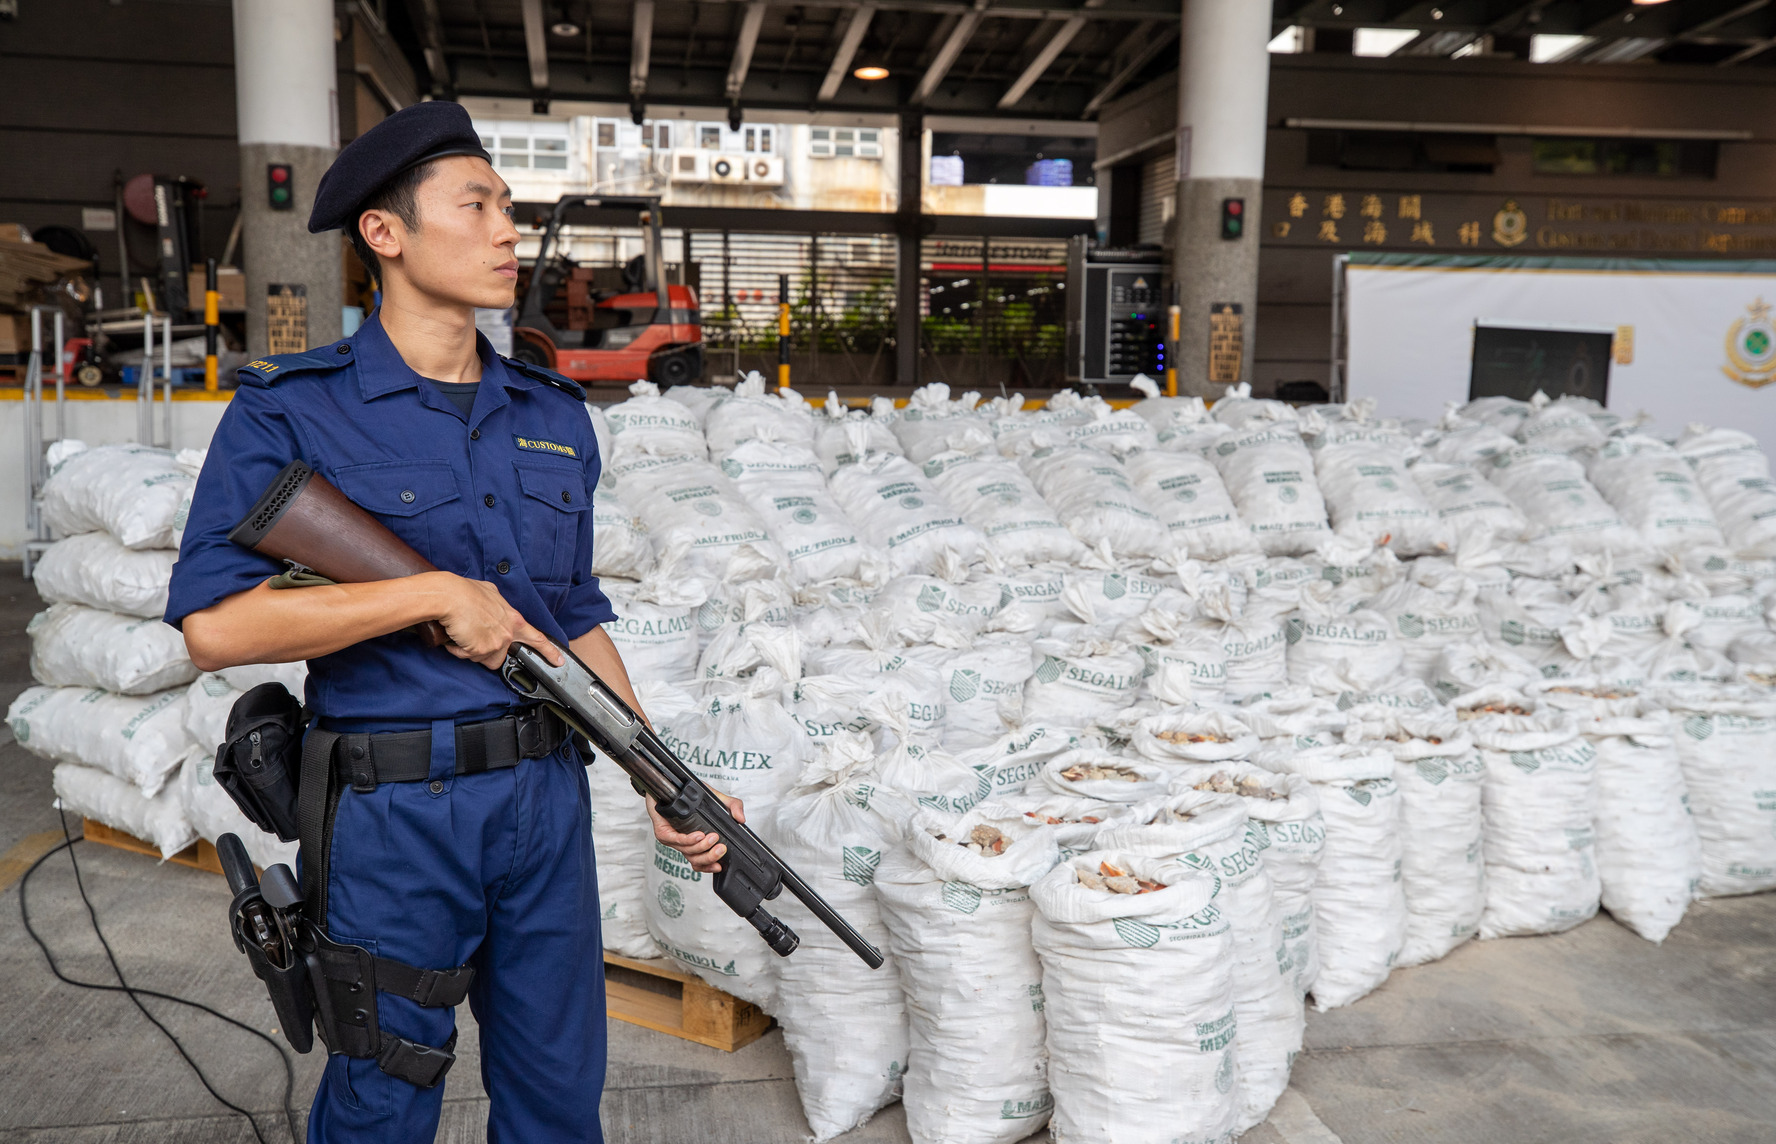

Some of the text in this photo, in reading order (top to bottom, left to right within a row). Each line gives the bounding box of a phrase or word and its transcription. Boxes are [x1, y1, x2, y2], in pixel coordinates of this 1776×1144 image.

[1074, 421, 1147, 438] SEGALMEX
[528, 440, 567, 453] CUSTOMS
[654, 853, 702, 882] MÉXICO
[1169, 932, 1206, 942] SEGURIDAD
